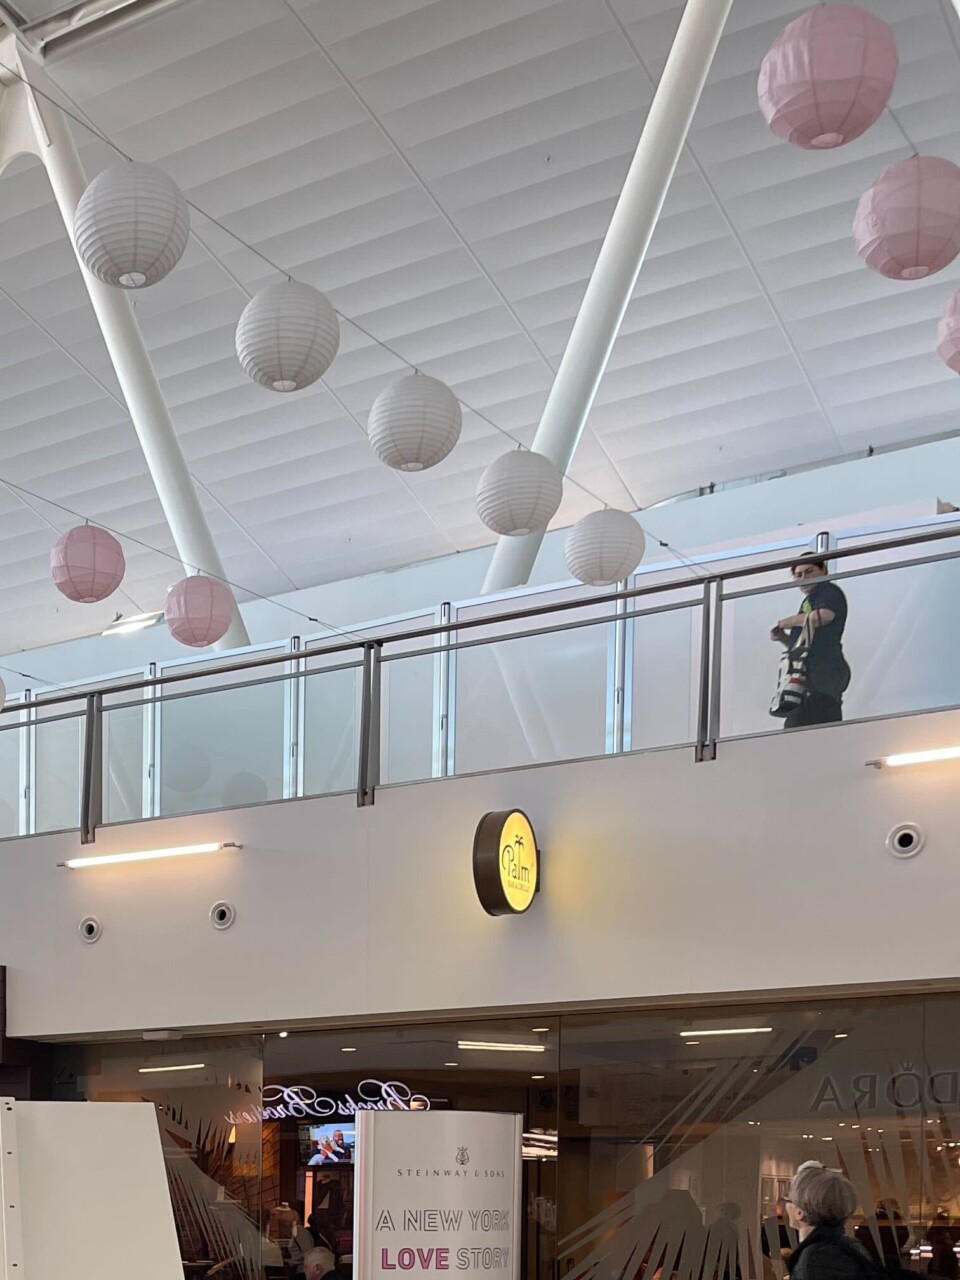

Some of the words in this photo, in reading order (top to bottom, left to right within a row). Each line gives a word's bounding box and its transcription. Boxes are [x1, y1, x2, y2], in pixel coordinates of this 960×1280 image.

[502, 836, 530, 883] Palm
[397, 1169, 468, 1177] STEINWAY
[484, 1170, 505, 1178] SONS
[375, 1209, 396, 1231] A
[403, 1209, 463, 1231] NEW
[468, 1209, 510, 1231] YORK
[381, 1247, 450, 1270] LOVE
[456, 1247, 509, 1270] STORY
